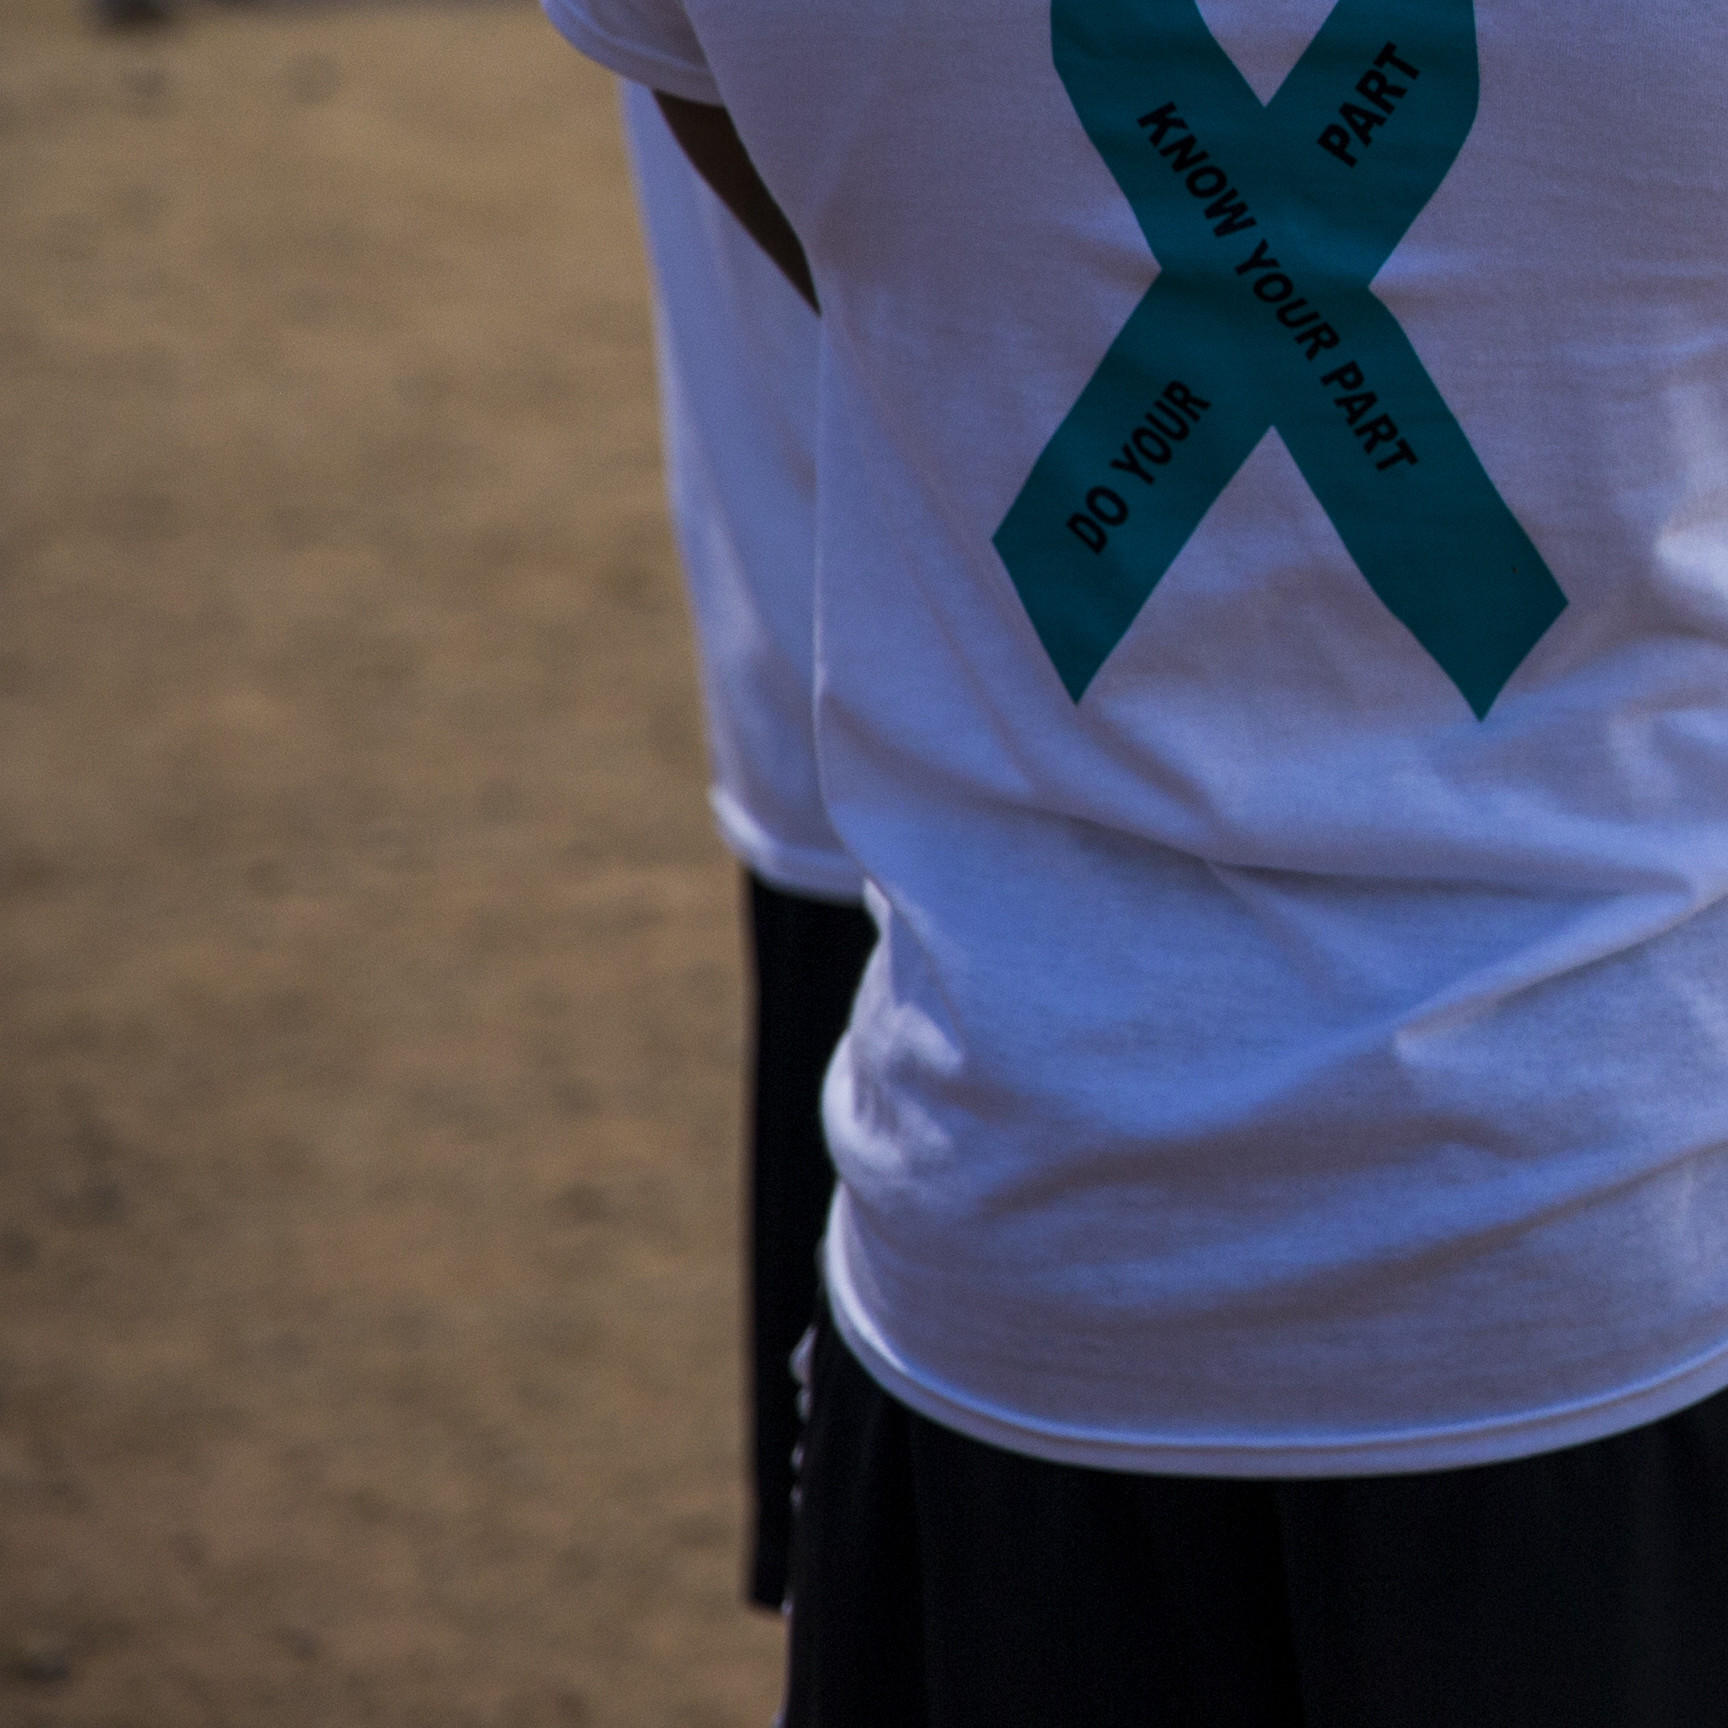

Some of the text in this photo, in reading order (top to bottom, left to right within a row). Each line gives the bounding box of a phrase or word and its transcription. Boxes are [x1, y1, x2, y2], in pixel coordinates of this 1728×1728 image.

[1067, 43, 1420, 553] DO YOUR PART
[1137, 102, 1418, 471] KNOW YOUR PART
